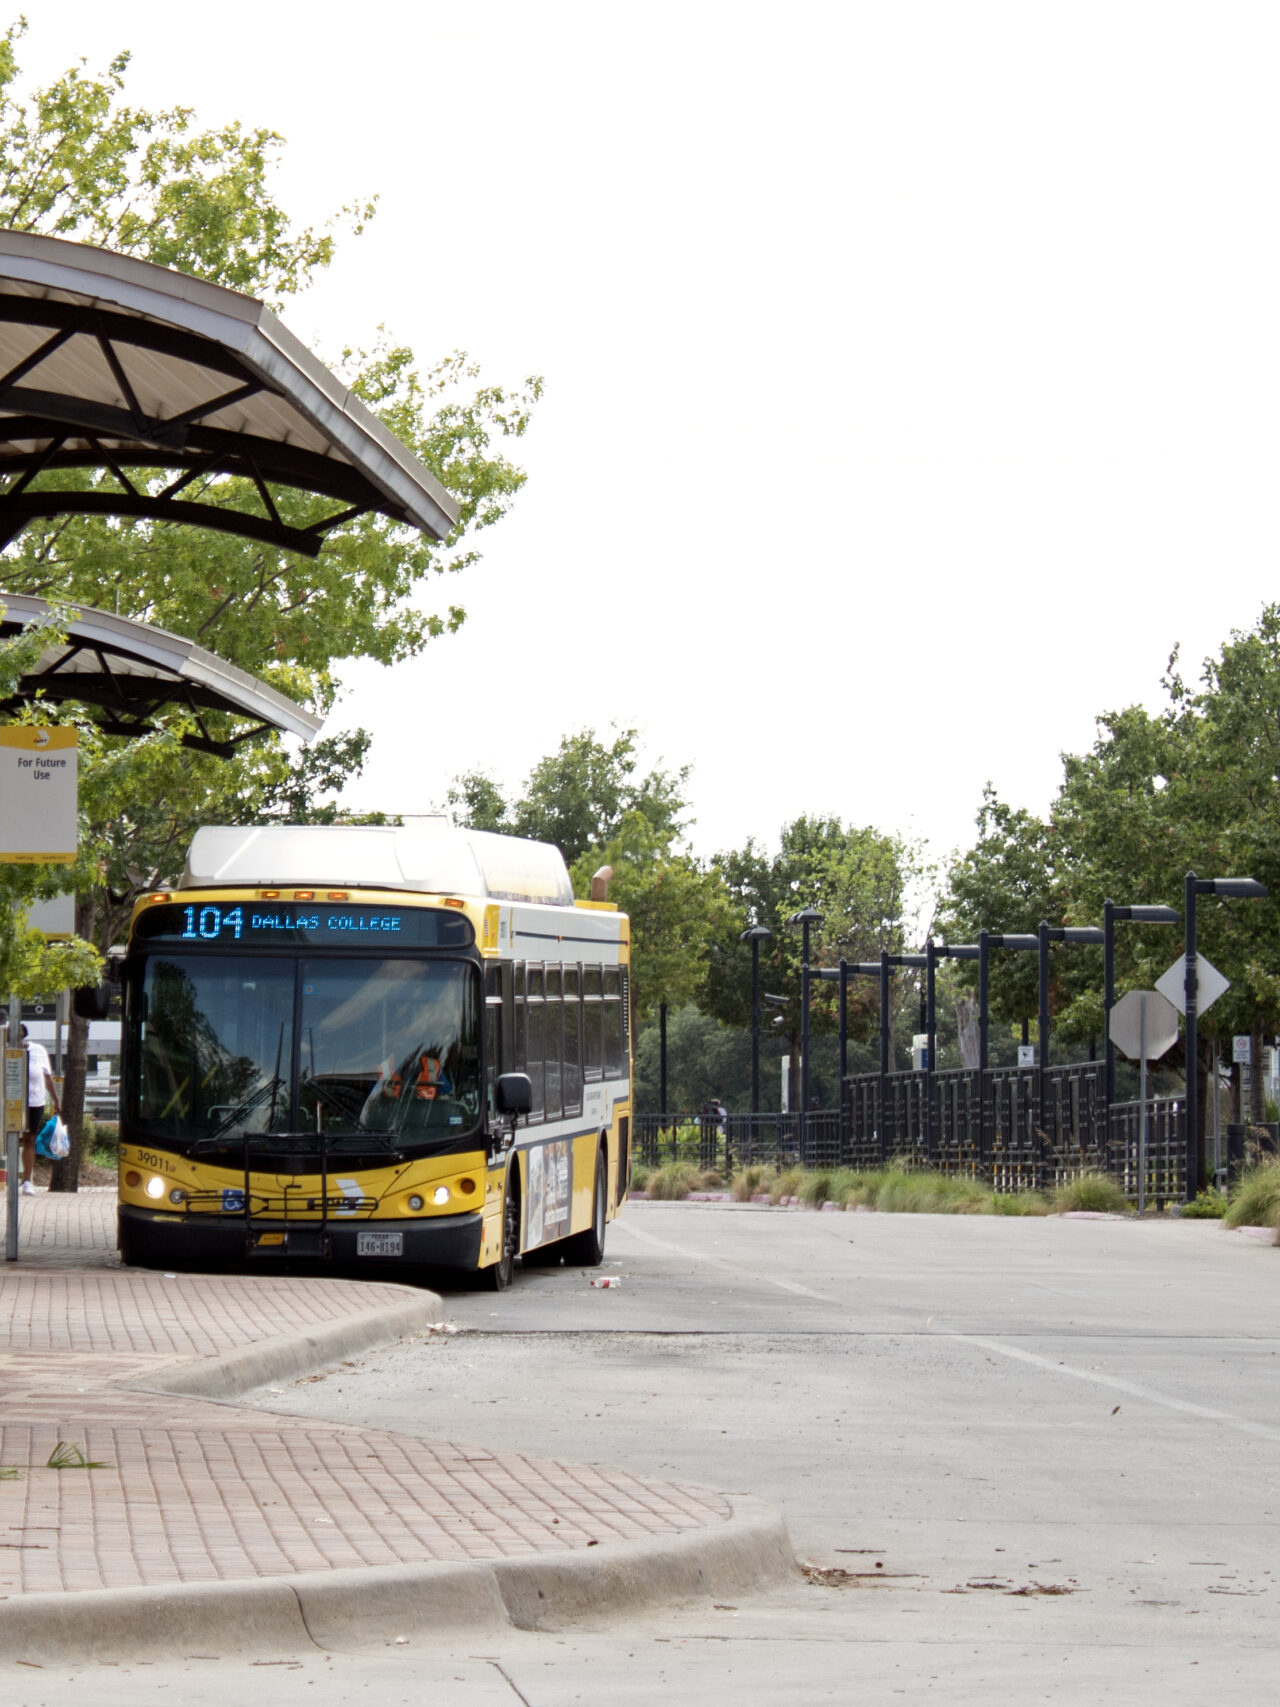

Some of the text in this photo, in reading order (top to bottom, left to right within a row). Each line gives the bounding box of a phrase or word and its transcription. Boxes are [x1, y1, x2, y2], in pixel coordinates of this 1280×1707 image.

[18, 757, 66, 768] For Future
[33, 770, 51, 780] Use
[182, 906, 401, 939] 104 DALLAS COLLEGE
[137, 1149, 169, 1171] 39011
